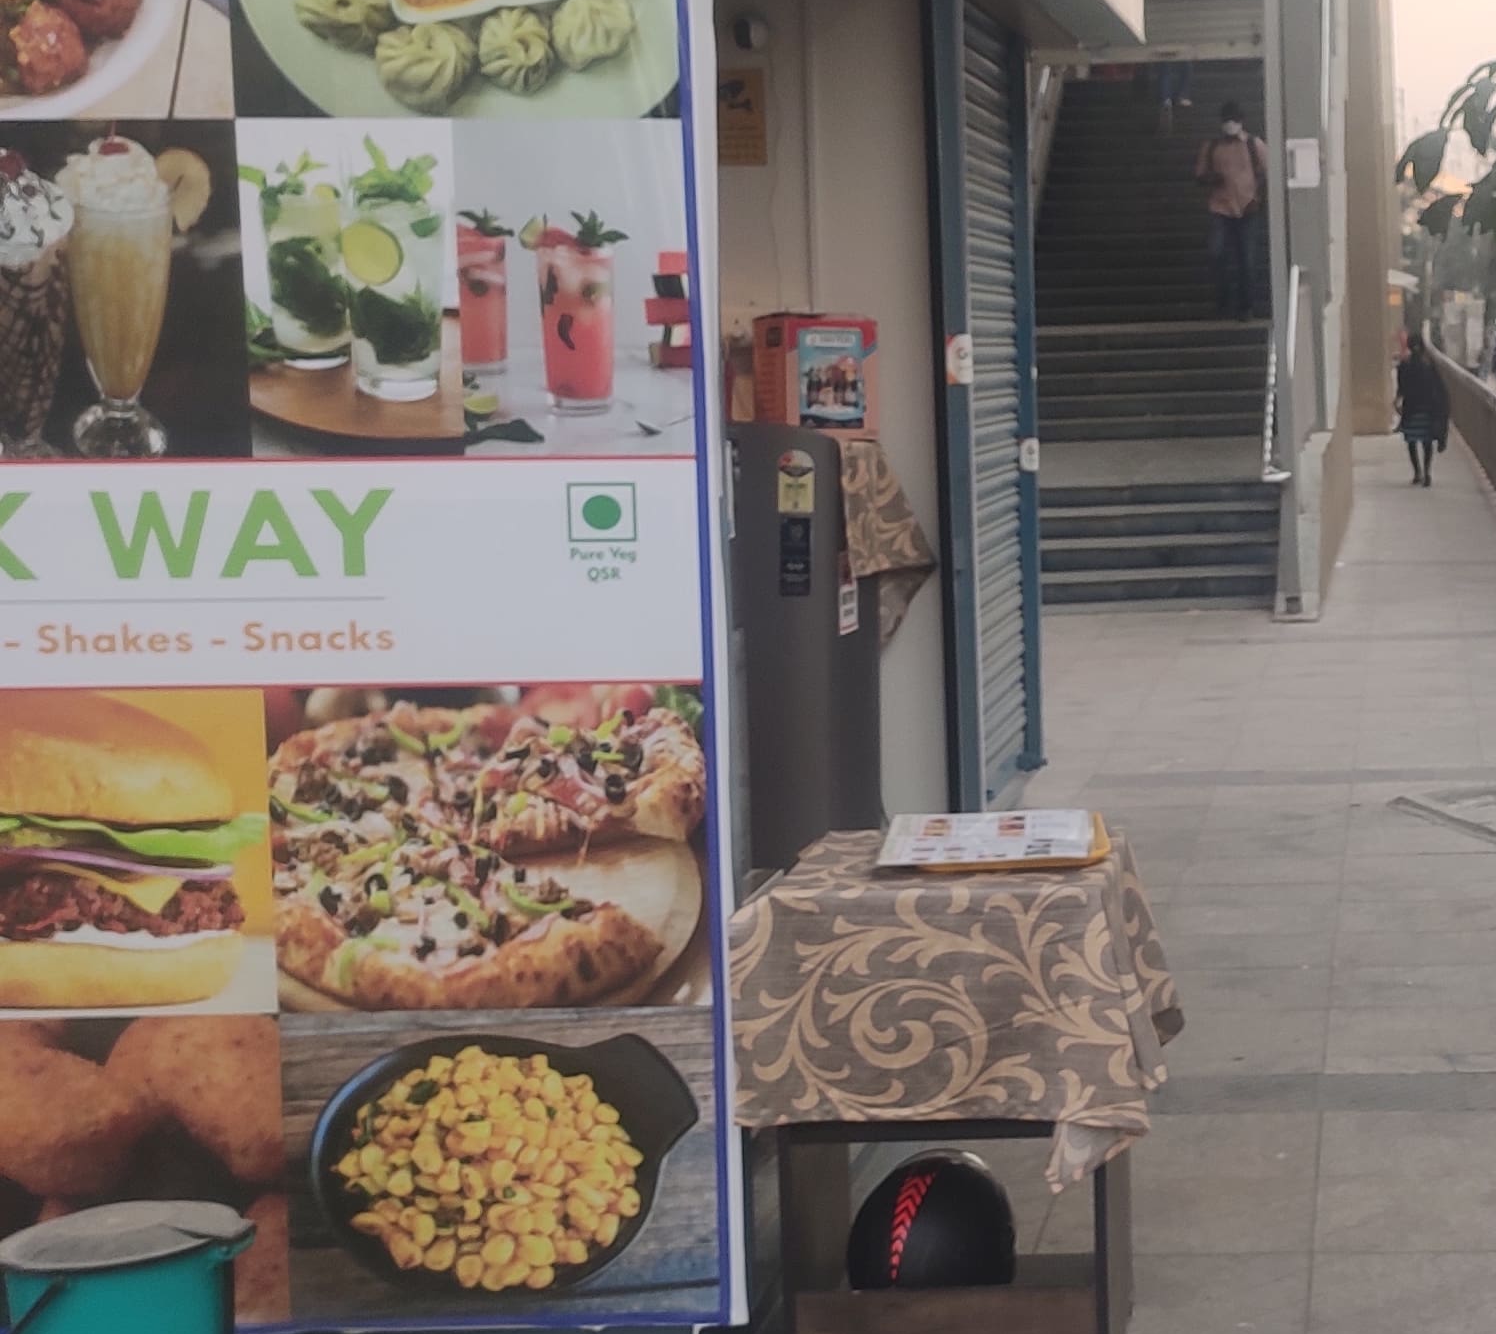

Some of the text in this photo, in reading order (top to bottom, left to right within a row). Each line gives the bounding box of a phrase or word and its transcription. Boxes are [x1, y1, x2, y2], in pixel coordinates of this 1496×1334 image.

[89, 488, 395, 581] WAY
[570, 546, 637, 564] Pure Veg
[587, 566, 622, 584] QSR
[36, 623, 194, 655] Shakes
[242, 621, 395, 653] Snacks
